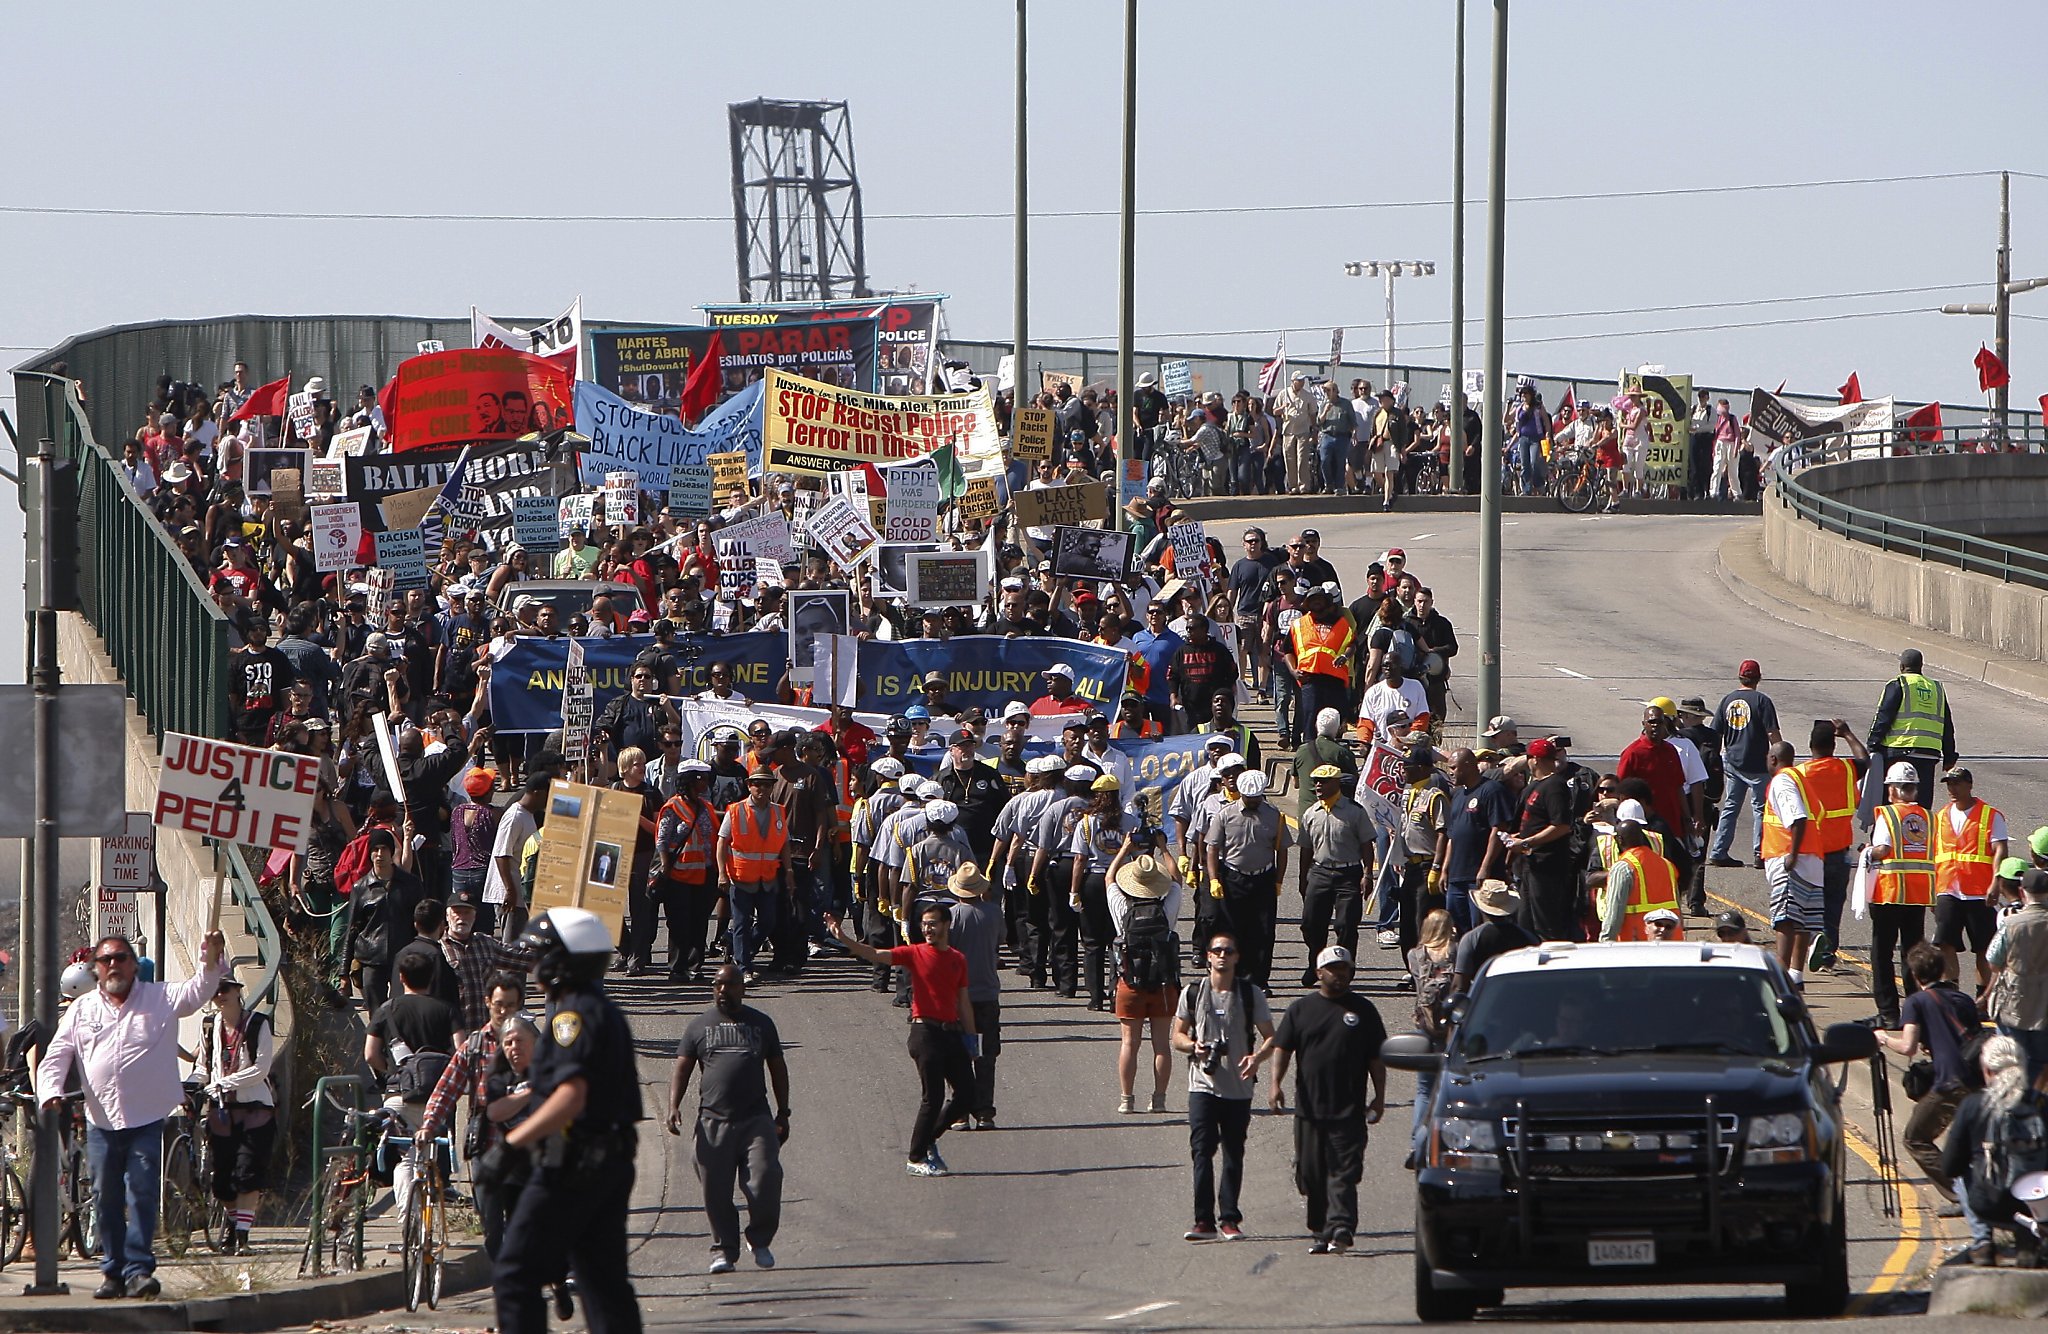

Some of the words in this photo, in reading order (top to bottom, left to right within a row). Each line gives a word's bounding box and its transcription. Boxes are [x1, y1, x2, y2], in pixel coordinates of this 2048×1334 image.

[714, 314, 779, 325] TUESDAY
[529, 317, 573, 354] NO
[739, 326, 850, 355] PARAR
[878, 330, 926, 341] POLICE
[617, 337, 668, 350] MARTES
[618, 350, 632, 361] 14
[636, 349, 651, 360] de
[655, 347, 690, 359] ABRIL
[778, 354, 797, 366] por
[863, 398, 898, 412] Mike,
[594, 401, 643, 429] STOP
[779, 390, 829, 424] STOP
[833, 402, 902, 435] Racist
[907, 412, 977, 438] Police
[1024, 411, 1046, 422] STOP
[1020, 421, 1048, 432] Racist
[786, 418, 850, 451] Terror
[855, 428, 878, 455] in
[882, 432, 919, 459] the
[1020, 434, 1046, 445] Police
[592, 428, 652, 465] BLACK
[656, 436, 707, 467] LIVES
[1018, 444, 1046, 455] Terror!
[707, 457, 722, 467] Stop
[787, 455, 831, 470] ANSWER
[674, 467, 709, 477] RACISM
[721, 466, 744, 477] Black
[605, 479, 636, 490] INJURY
[673, 480, 709, 490] Disease!
[890, 471, 937, 487] PEDIE
[966, 480, 989, 491] error
[615, 490, 636, 500] ONE
[671, 492, 708, 500] REVOLUTION
[901, 488, 923, 497] WAS
[960, 491, 995, 505] Policial
[1036, 485, 1086, 505] BLACK
[516, 499, 555, 509] RACISM
[565, 495, 586, 508] WE
[888, 500, 937, 510] MURDERED
[960, 500, 998, 515] Racista!
[1044, 500, 1084, 512] LIVES
[328, 515, 344, 523] UNION
[517, 513, 556, 522] Disease!
[567, 507, 591, 518] ARE
[811, 521, 821, 531] NO
[818, 500, 847, 525] EXECUTION
[1039, 508, 1087, 526] MATTER
[890, 517, 932, 528] COLD
[517, 526, 557, 535] REVOLUTION
[887, 528, 932, 541] BLOOD
[1171, 522, 1199, 538] STOP
[378, 531, 420, 544] RACISM
[1171, 532, 1204, 548] POLICE
[328, 550, 342, 560] Injury
[380, 546, 422, 559] Disease!
[720, 541, 752, 557] JAIL
[380, 561, 424, 570] REVOLUTION
[720, 558, 756, 572] KILLER
[721, 571, 757, 588] COPS
[245, 662, 273, 681] STO
[527, 668, 563, 691] AN
[876, 675, 900, 696] IS
[950, 671, 1038, 692] INJURY
[1074, 677, 1110, 703] ALL
[567, 685, 585, 697] BLACK
[567, 714, 591, 727] MATTER
[166, 737, 320, 796] JUSTICE
[218, 777, 245, 811] 4
[154, 790, 301, 852] PEDIE
[104, 836, 150, 851] PARKING
[114, 853, 137, 866] ANY
[113, 867, 139, 881] TIME
[101, 889, 115, 901] NO
[100, 903, 134, 914] PARKING
[108, 916, 125, 925] ANY
[107, 926, 126, 936] TIME
[705, 1026, 762, 1048] RAIDERS
